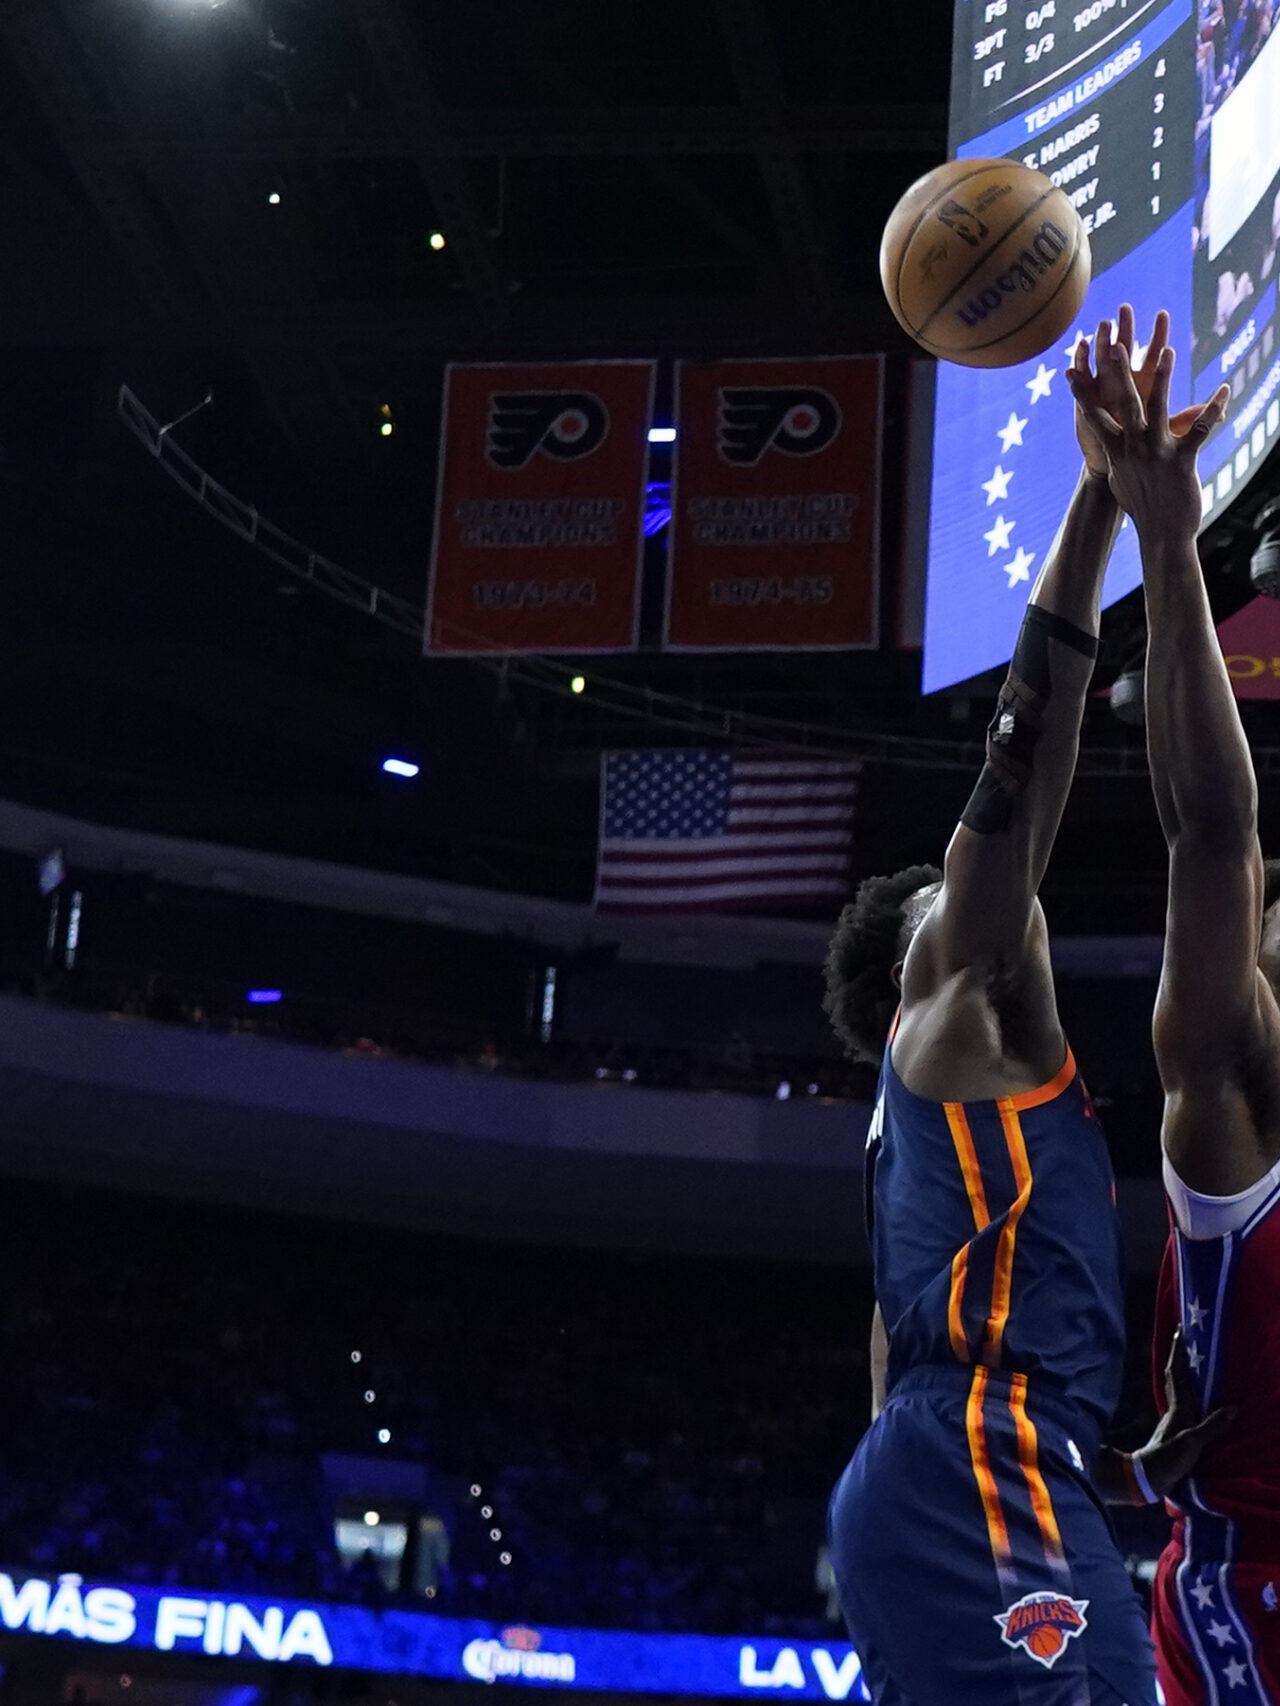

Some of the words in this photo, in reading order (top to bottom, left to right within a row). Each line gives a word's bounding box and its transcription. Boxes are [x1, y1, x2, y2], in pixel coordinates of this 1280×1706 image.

[974, 28, 1007, 60] 3PT
[983, 61, 1006, 88] FT
[1024, 33, 1055, 63] 3/3
[1024, 89, 1073, 133] TEAM
[1075, 40, 1142, 104] LEADERS
[1040, 113, 1100, 165] HARRIS
[1050, 144, 1100, 187] OWRY
[1153, 93, 1165, 114] 3
[1152, 126, 1164, 148] 2
[1152, 161, 1161, 180] 1
[1151, 195, 1160, 215] 1
[957, 221, 1068, 326] Wilson
[154, 1596, 334, 1666] FINA
[1005, 1598, 1083, 1639] KNICKS
[739, 1645, 806, 1689] LA
